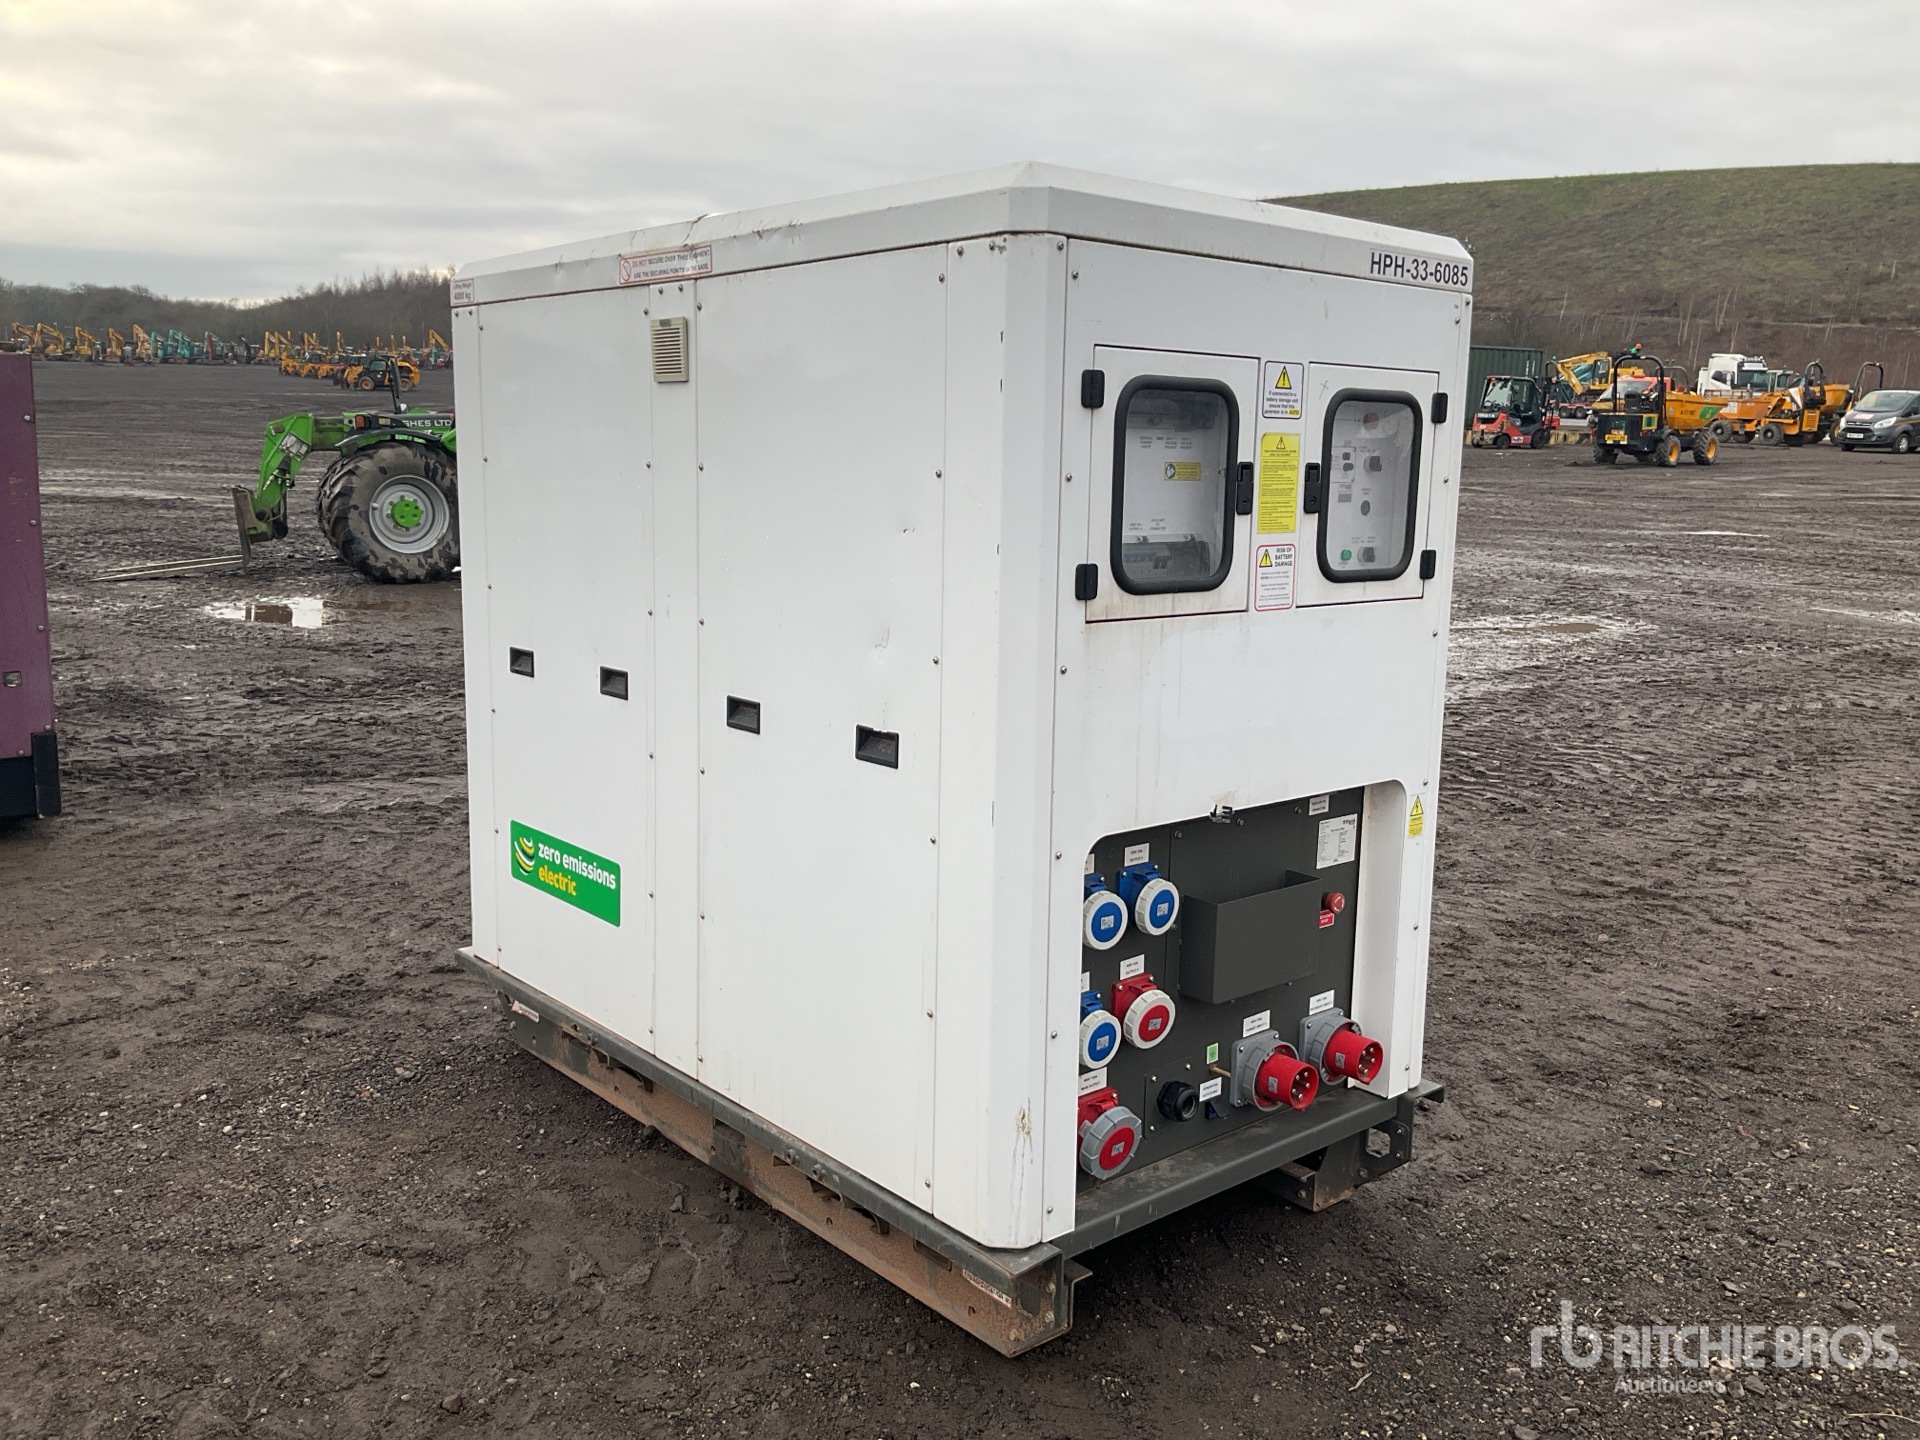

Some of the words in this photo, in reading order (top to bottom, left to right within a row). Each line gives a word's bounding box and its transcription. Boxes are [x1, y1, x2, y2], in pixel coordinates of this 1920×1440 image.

[648, 257, 664, 265] SECURE
[665, 255, 676, 263] OVER
[677, 253, 689, 261] THIS
[1370, 252, 1468, 286] HPH-33-6085
[538, 843, 560, 865] zero
[562, 853, 616, 889] emissions
[538, 865, 576, 896] electric
